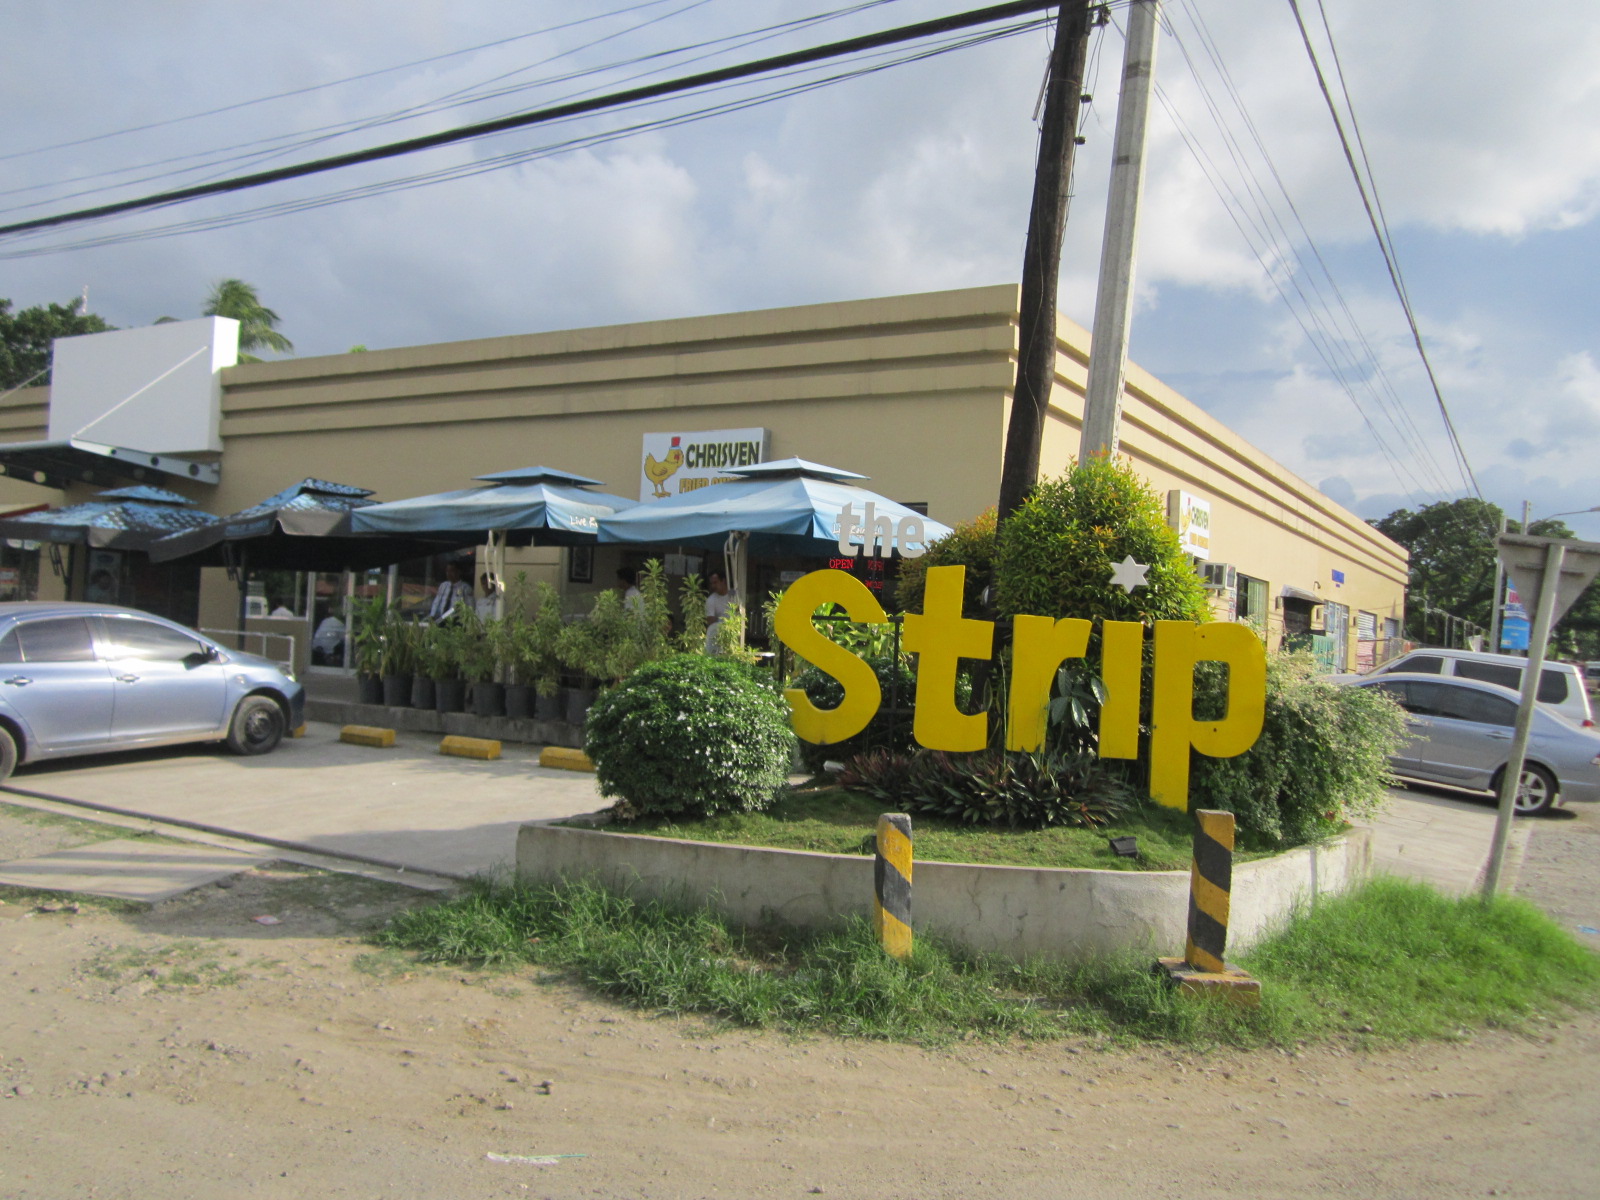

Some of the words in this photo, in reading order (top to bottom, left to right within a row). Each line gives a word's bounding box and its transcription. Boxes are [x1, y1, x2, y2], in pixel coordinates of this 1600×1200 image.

[685, 441, 760, 469] CHRISVEN
[836, 501, 926, 558] the
[829, 558, 854, 569] OPEN
[773, 564, 1266, 814] Strip
